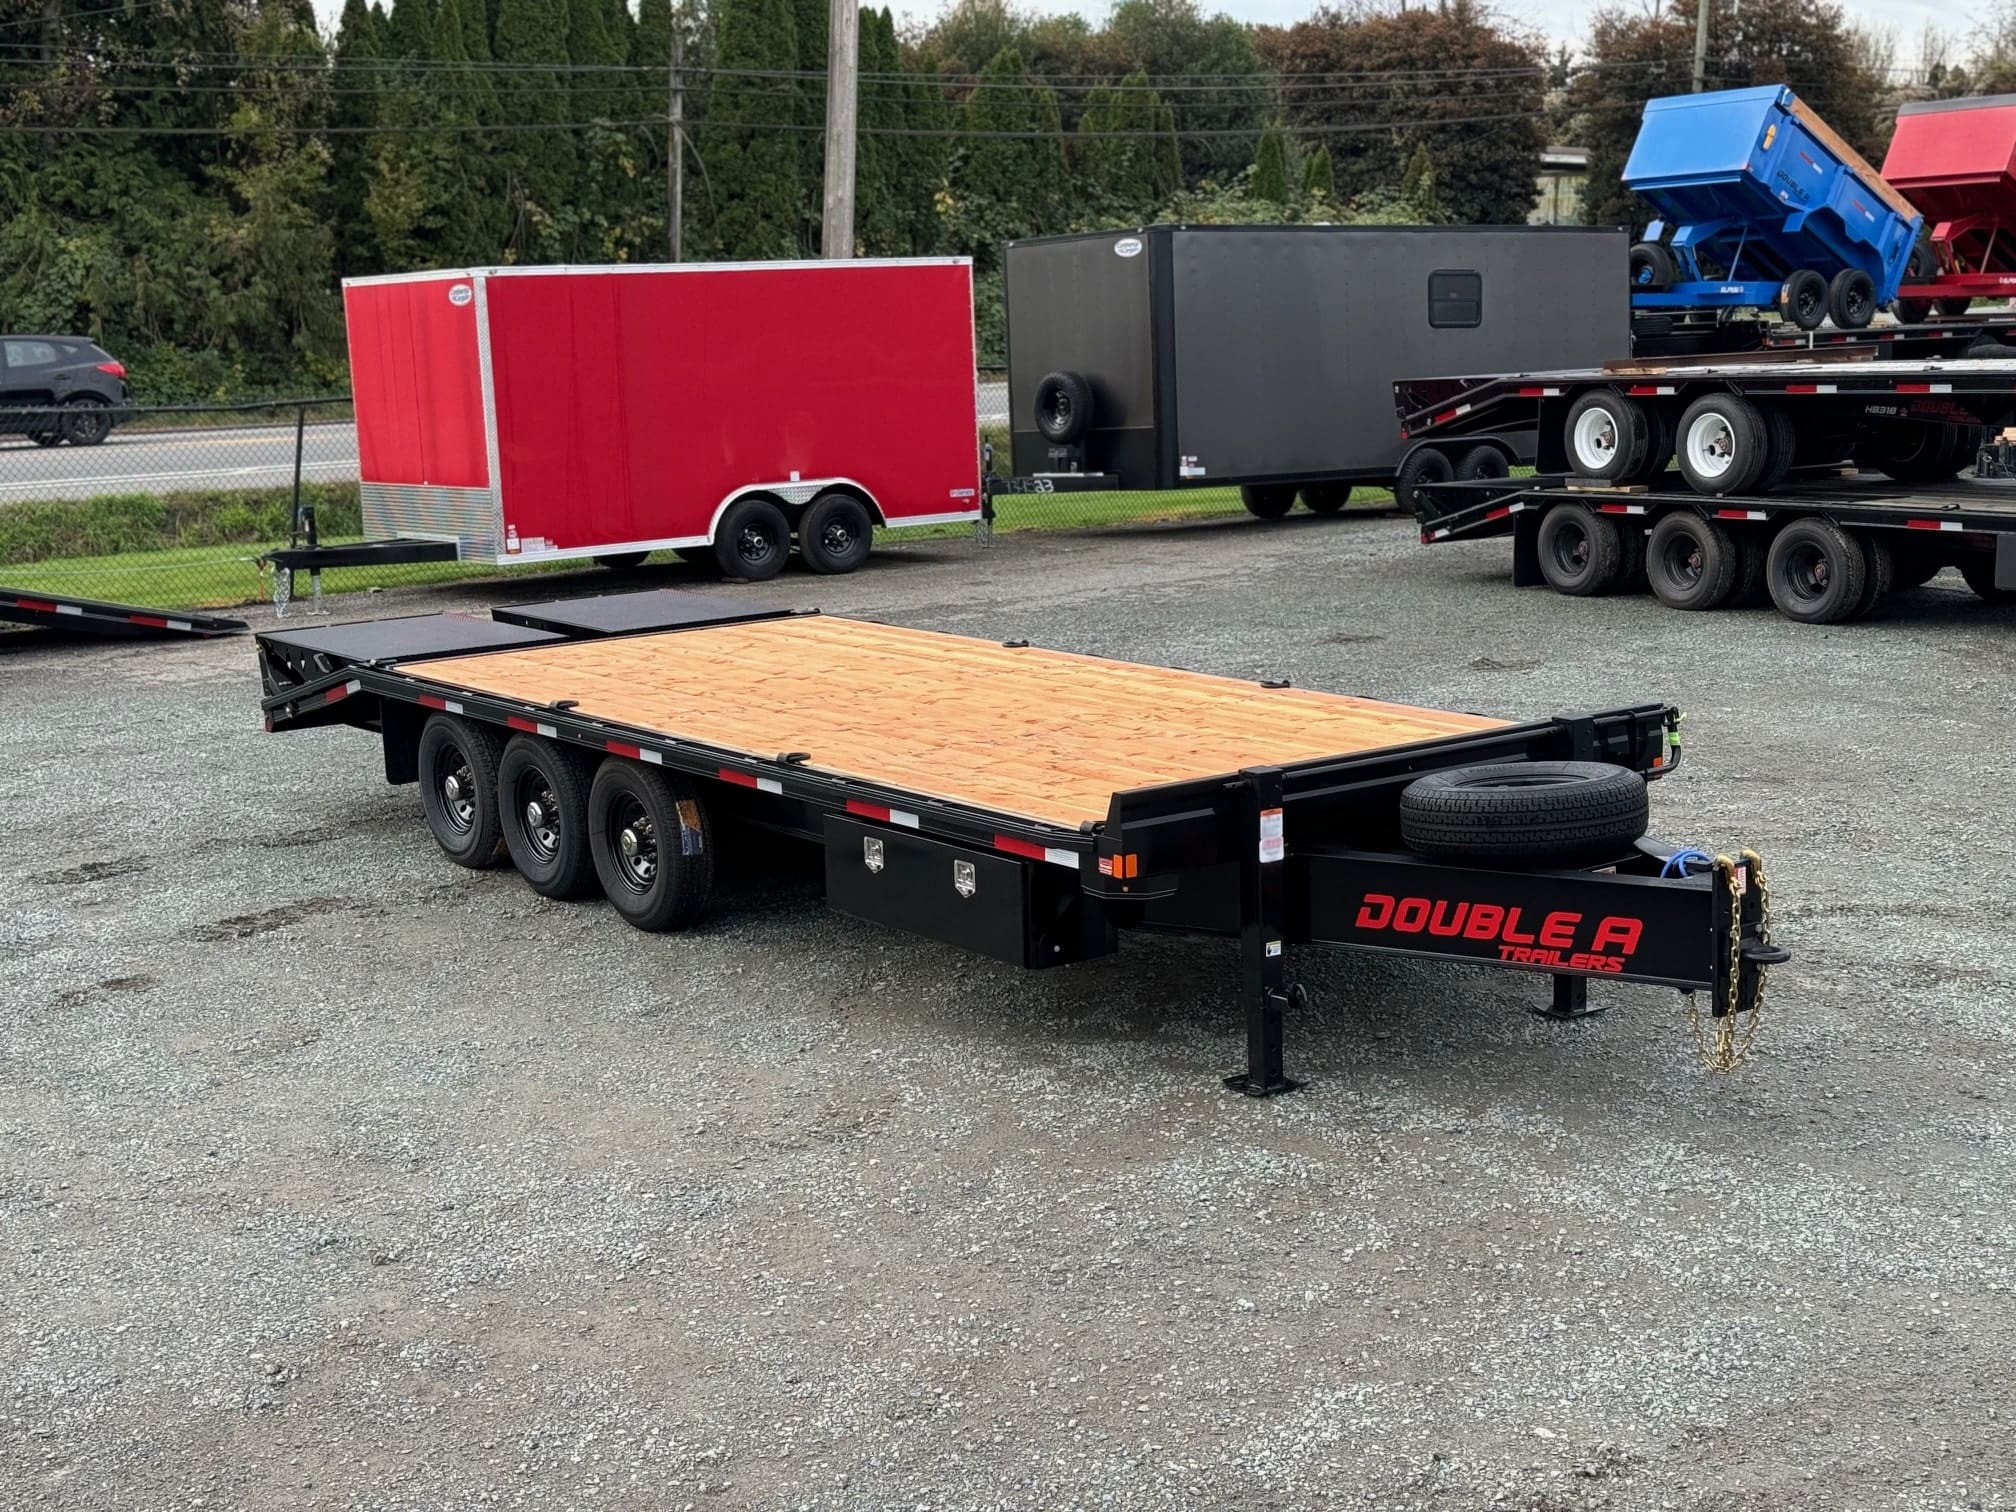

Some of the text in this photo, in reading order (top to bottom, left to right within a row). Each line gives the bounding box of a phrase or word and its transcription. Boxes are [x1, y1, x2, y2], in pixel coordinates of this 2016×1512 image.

[1355, 894, 1643, 955] DOUBLE A
[1498, 945, 1626, 973] TRAILERS
